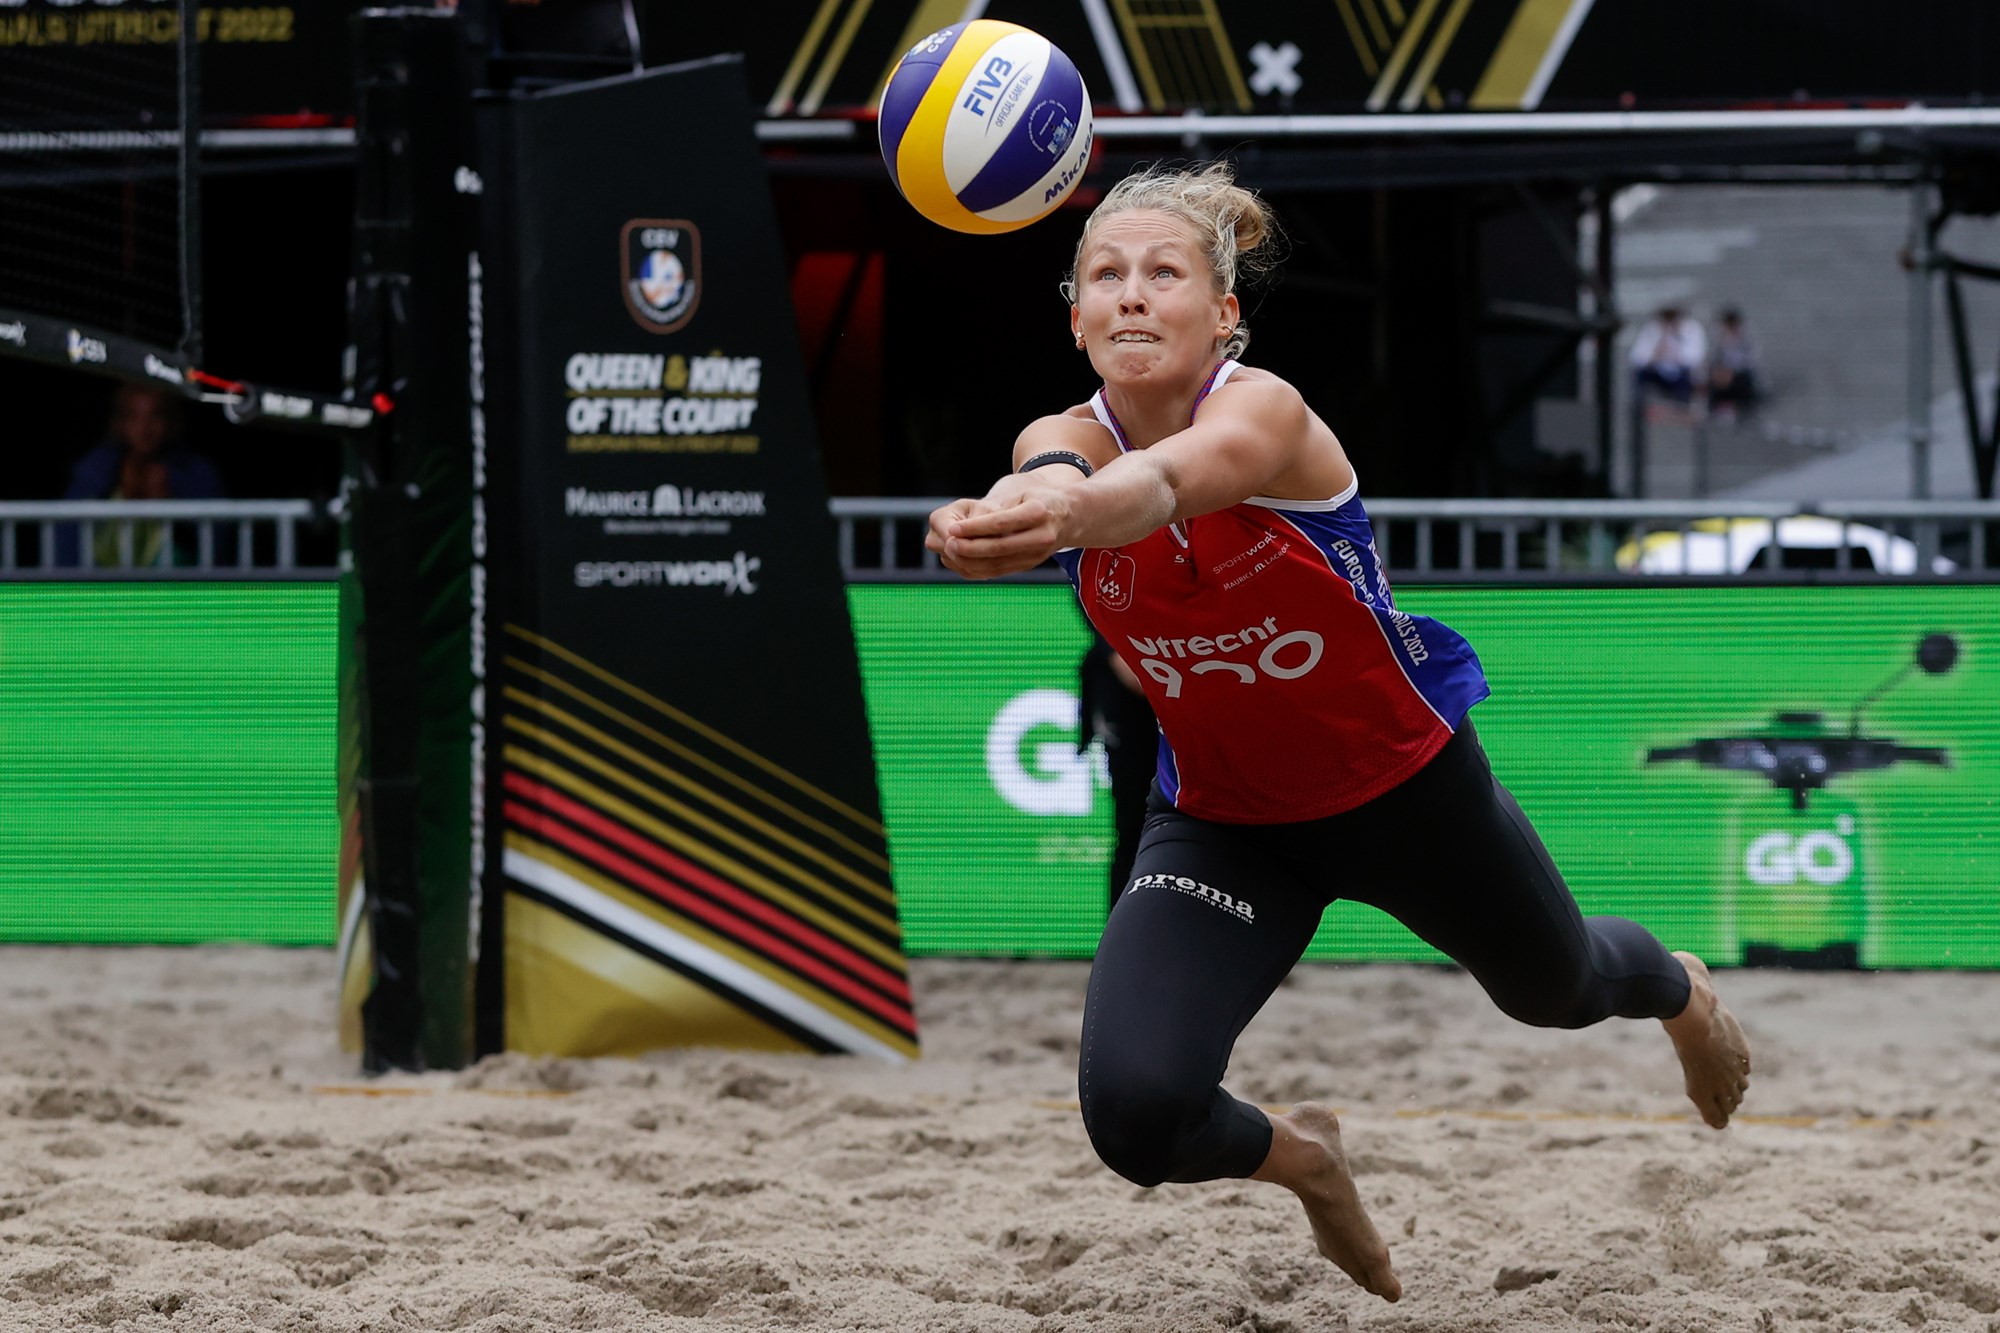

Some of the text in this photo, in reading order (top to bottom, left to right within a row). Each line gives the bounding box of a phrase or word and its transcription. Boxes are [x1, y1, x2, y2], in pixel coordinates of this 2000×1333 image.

[927, 30, 953, 53] CEV
[963, 57, 1012, 117] FIVB
[995, 101, 1015, 128] OFFICIAL
[1009, 83, 1026, 102] GAME
[565, 353, 761, 393] QUEEN & KING
[566, 397, 759, 435] OF THE COURT
[1402, 634, 1429, 666] 2022
[1128, 873, 1255, 919] prema
[1170, 884, 1216, 907] handling
[1218, 903, 1253, 925] systems
